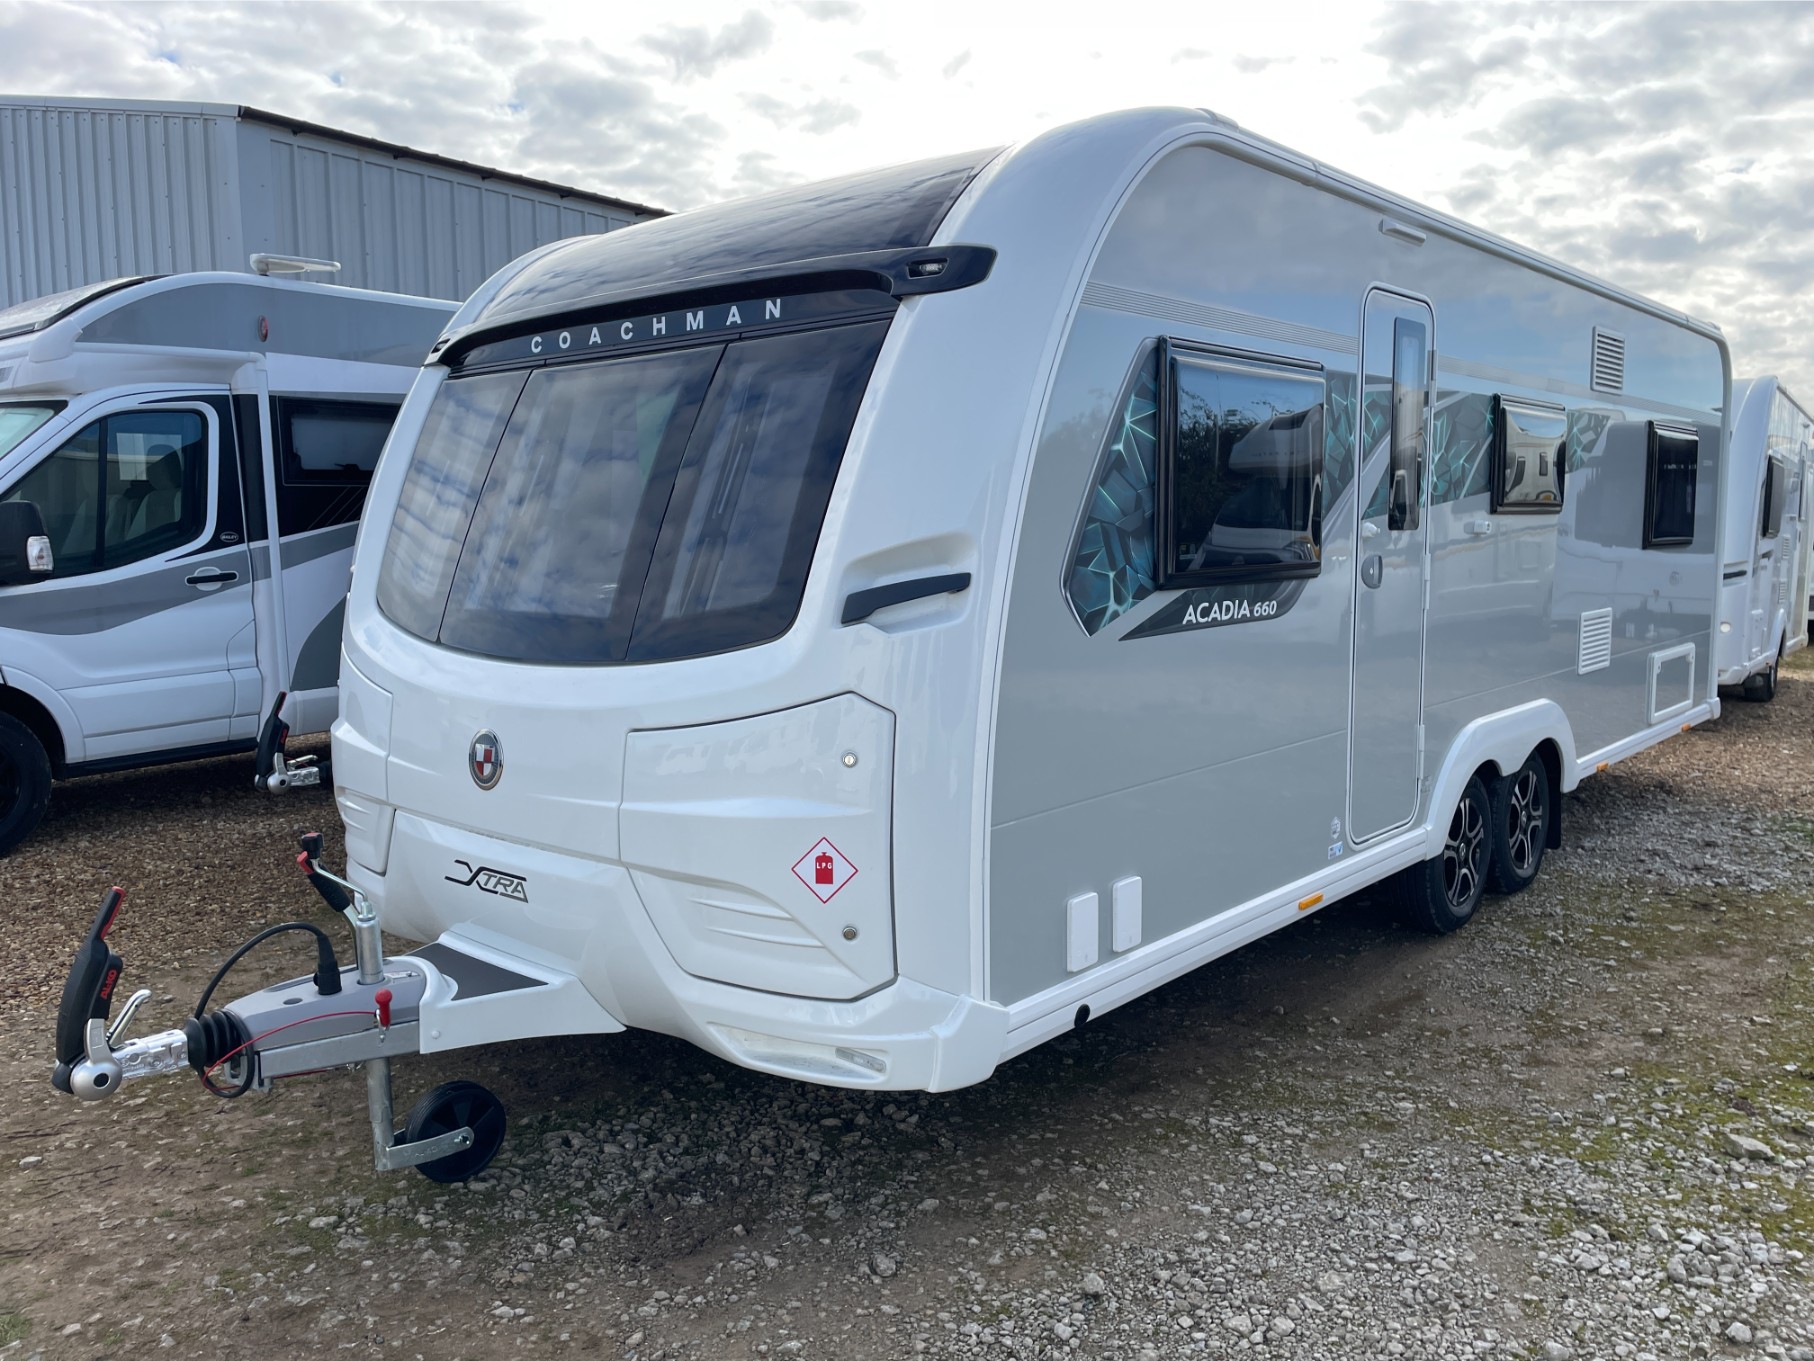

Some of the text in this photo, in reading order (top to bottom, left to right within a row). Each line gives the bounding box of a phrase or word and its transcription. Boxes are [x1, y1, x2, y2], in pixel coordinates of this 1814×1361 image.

[530, 298, 782, 354] COACHMAN
[1182, 599, 1278, 625] ACADIA 660
[444, 859, 529, 903] XTRA
